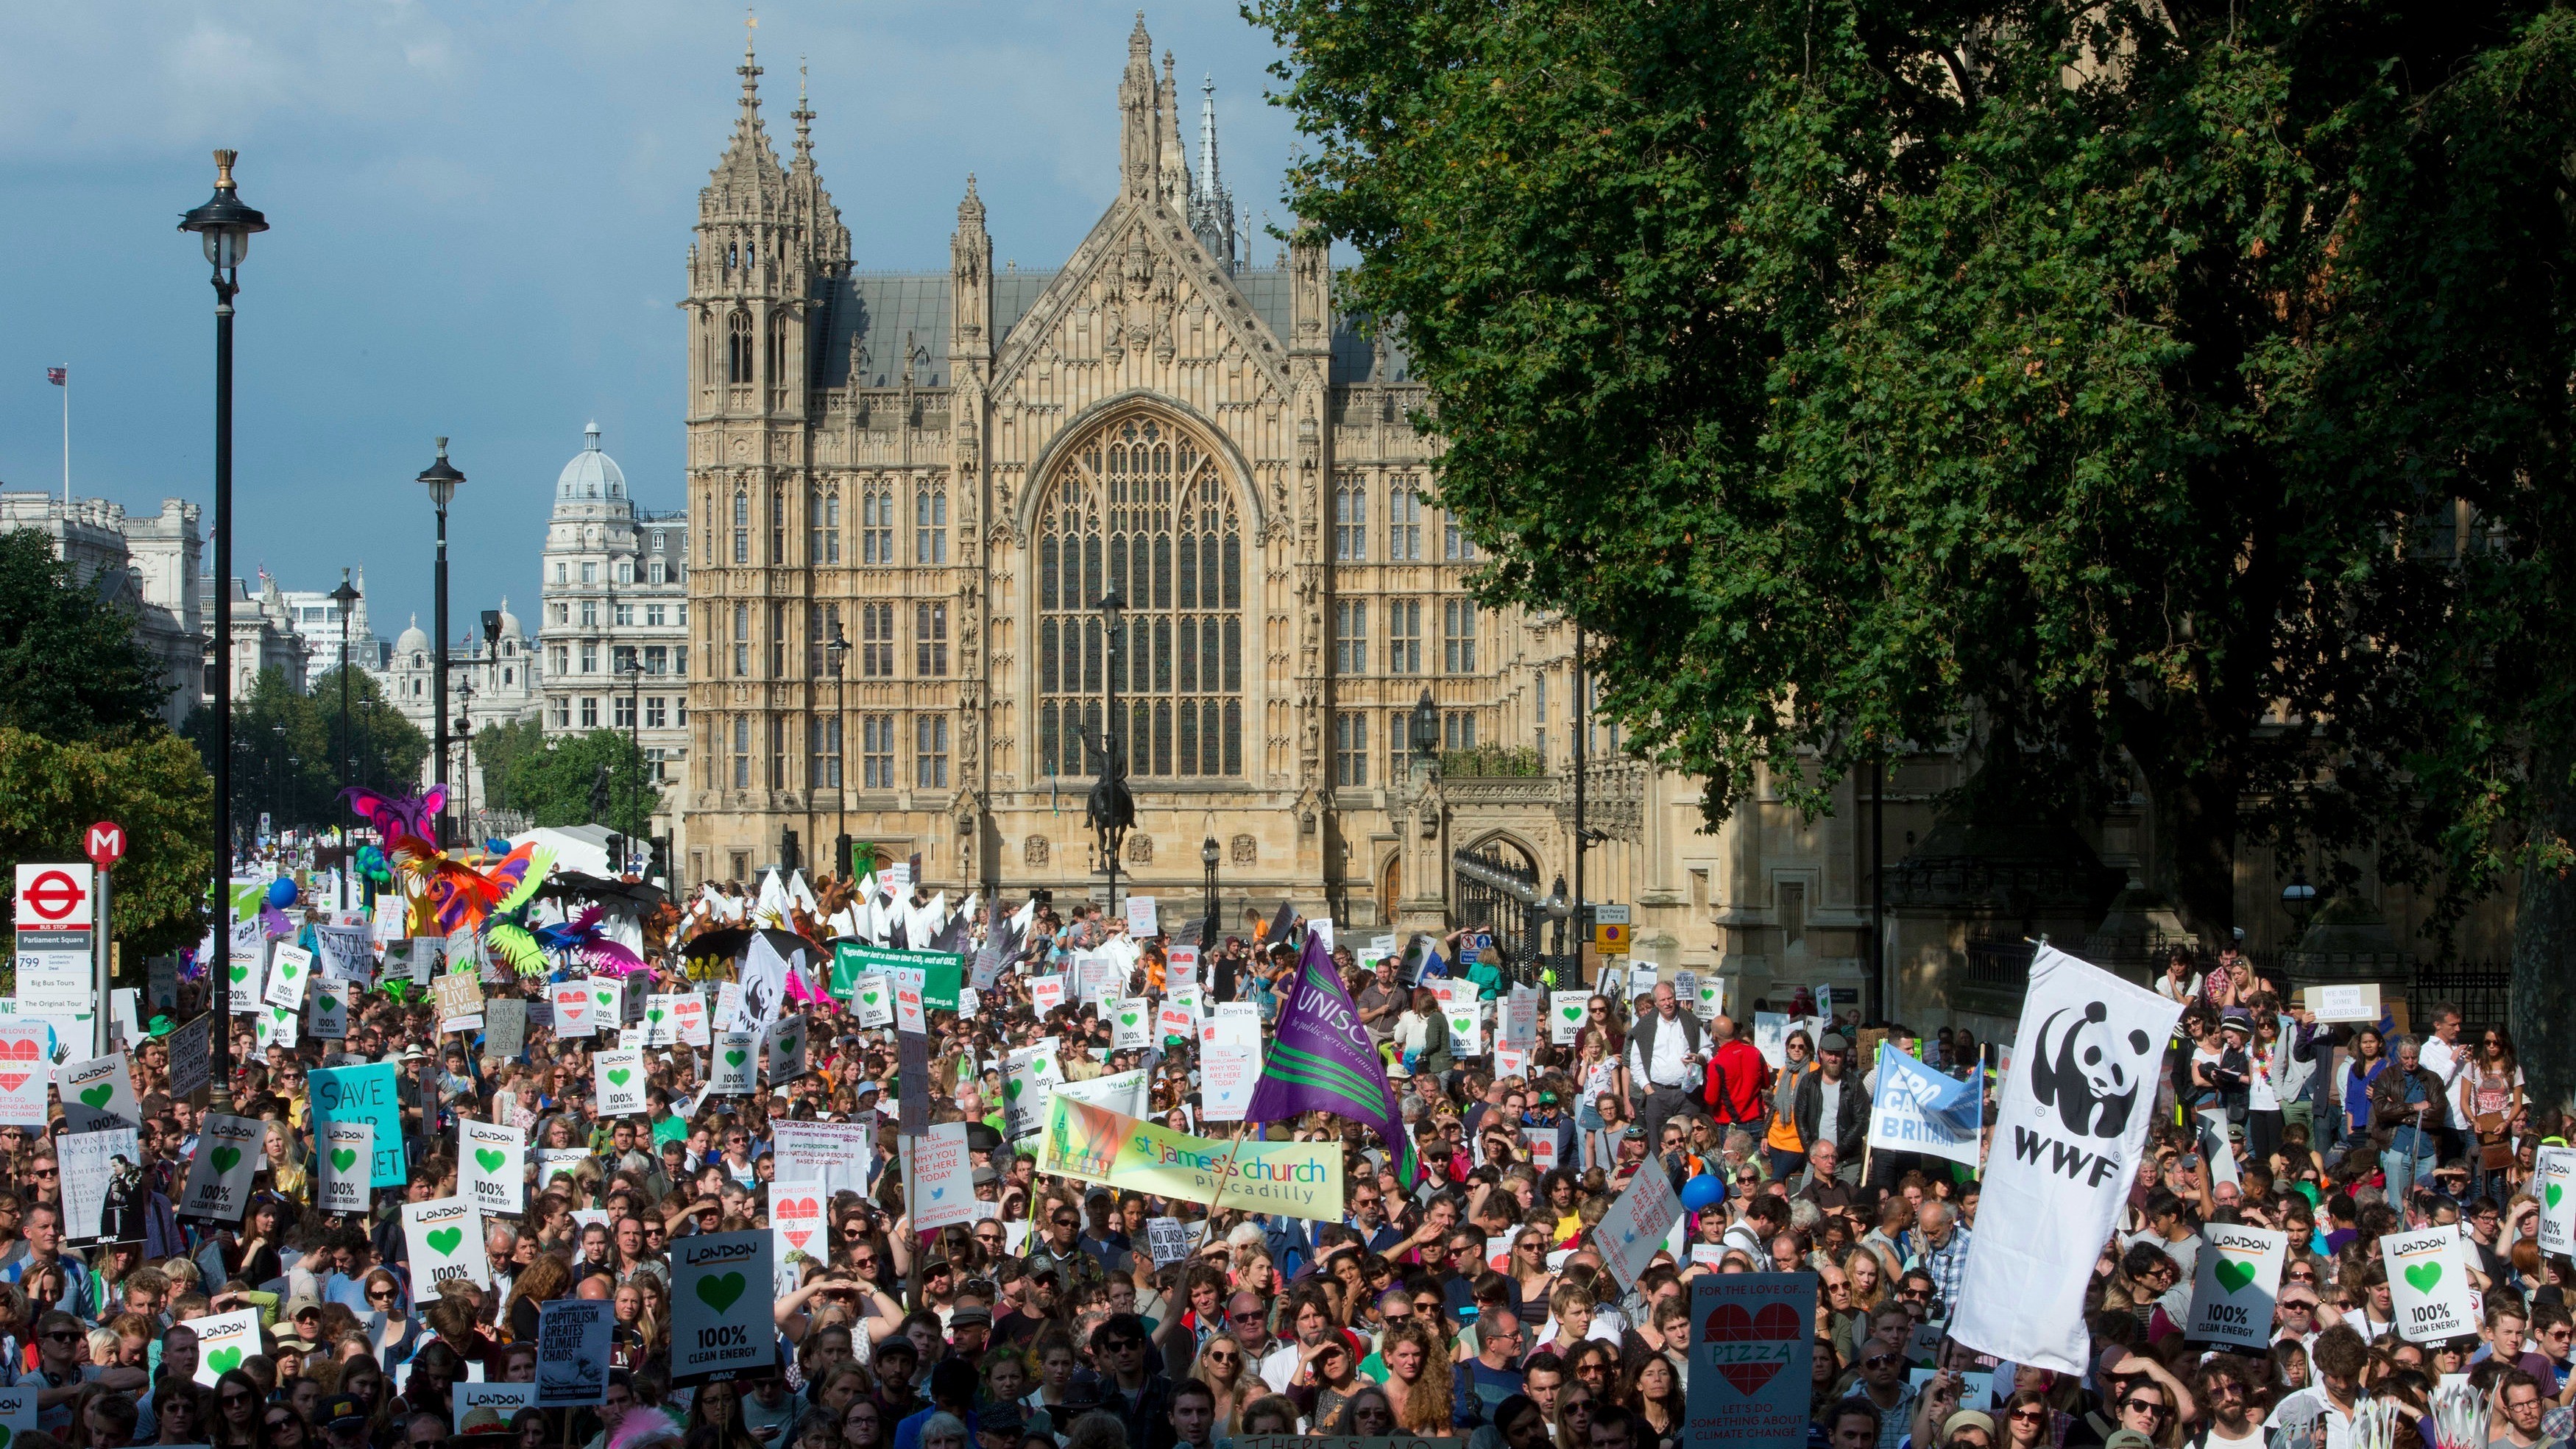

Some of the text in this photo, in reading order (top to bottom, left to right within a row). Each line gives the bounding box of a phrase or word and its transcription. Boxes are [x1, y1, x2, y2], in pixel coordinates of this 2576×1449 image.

[91, 829, 118, 856] M
[60, 936, 84, 944] Square
[282, 949, 306, 961] LONDON
[842, 946, 870, 958] Together
[870, 951, 885, 959] let's
[885, 952, 899, 960] take
[19, 957, 40, 968] 799
[277, 984, 294, 997] 100%
[434, 974, 472, 992] WE CAN'T
[858, 980, 881, 990] LONDON
[39, 1000, 66, 1008] Original
[445, 987, 472, 1007] LIVE
[444, 1001, 482, 1017] ON MARS
[866, 1009, 882, 1018] 100%
[2318, 1007, 2369, 1017] LEADERSHIP
[318, 1018, 336, 1028] 100%
[775, 1020, 802, 1035] LONDON
[1122, 1032, 1140, 1040] 100%
[1453, 1038, 1471, 1046] 100%
[177, 1035, 204, 1063] PROFIT
[1297, 1021, 1324, 1037] public
[1323, 1033, 1356, 1057] service
[1355, 1056, 1380, 1081] union
[601, 1055, 635, 1064] LONDON
[779, 1059, 797, 1071] 100%
[68, 1063, 116, 1084] LONDON
[180, 1068, 209, 1094] DAMAGE
[723, 1074, 745, 1083] 100%
[320, 1079, 384, 1110] SAVE
[609, 1094, 633, 1103] 100%
[88, 1113, 121, 1132] 100%
[210, 1123, 257, 1138] LONDON
[328, 1130, 364, 1139] LONDON
[470, 1127, 514, 1142] LONDON
[73, 1133, 122, 1146] WINTER
[921, 1133, 942, 1144] TELL
[80, 1144, 132, 1155] COMING
[914, 1149, 957, 1164] WHY YOU
[2015, 1125, 2119, 1188] WWF
[546, 1154, 582, 1162] LONDON
[1135, 1136, 1326, 1183] st james's church
[66, 1166, 108, 1176] CAMERON
[913, 1158, 958, 1175] ARE HERE
[920, 1170, 952, 1183] TODAY
[200, 1184, 232, 1202] 100%
[329, 1182, 355, 1195] 100%
[475, 1180, 505, 1197] 100%
[1195, 1174, 1314, 1205] piccadilly
[1656, 1178, 1669, 1202] TELL
[487, 1197, 511, 1206] ENERGY
[941, 1203, 957, 1211] USING
[1638, 1183, 1663, 1227] WHY YOU
[416, 1204, 467, 1222] LONDON
[1632, 1194, 1659, 1236] ARE HERE
[1630, 1207, 1649, 1238] TODAY
[1150, 1229, 1184, 1244] NO DASH
[2212, 1233, 2271, 1250] LONDON
[686, 1241, 757, 1264] LONDON
[1153, 1244, 1186, 1259] FOR GAS
[2393, 1236, 2446, 1255] LONDON
[431, 1264, 468, 1283] 100%
[1699, 1286, 1722, 1297] FOR
[1725, 1286, 1747, 1295] THE
[1750, 1285, 1780, 1294] LOVE
[545, 1311, 599, 1325] CAPITALISM
[2207, 1303, 2249, 1324] 100%
[2411, 1303, 2450, 1323] 100%
[196, 1320, 247, 1341] LONDON
[545, 1325, 584, 1337] CREATES
[2198, 1322, 2254, 1337] CLEAN ENERGY
[2409, 1319, 2460, 1335] CLEAN ENERGY
[544, 1336, 582, 1350] CLIMATE
[698, 1325, 747, 1349] 100%
[2426, 1339, 2447, 1349] AVAAZ
[542, 1349, 573, 1361] CHAOS
[689, 1347, 757, 1364] CLEAN ENERGY
[1713, 1342, 1791, 1364] PIZZA
[709, 1371, 736, 1381] AVAAZ
[467, 1392, 525, 1406] LONDON
[1722, 1403, 1773, 1414] LET'S DO
[1691, 1415, 1803, 1428] SOMETHING ABOUT
[1695, 1428, 1797, 1440] CLIMATE CHANGE
